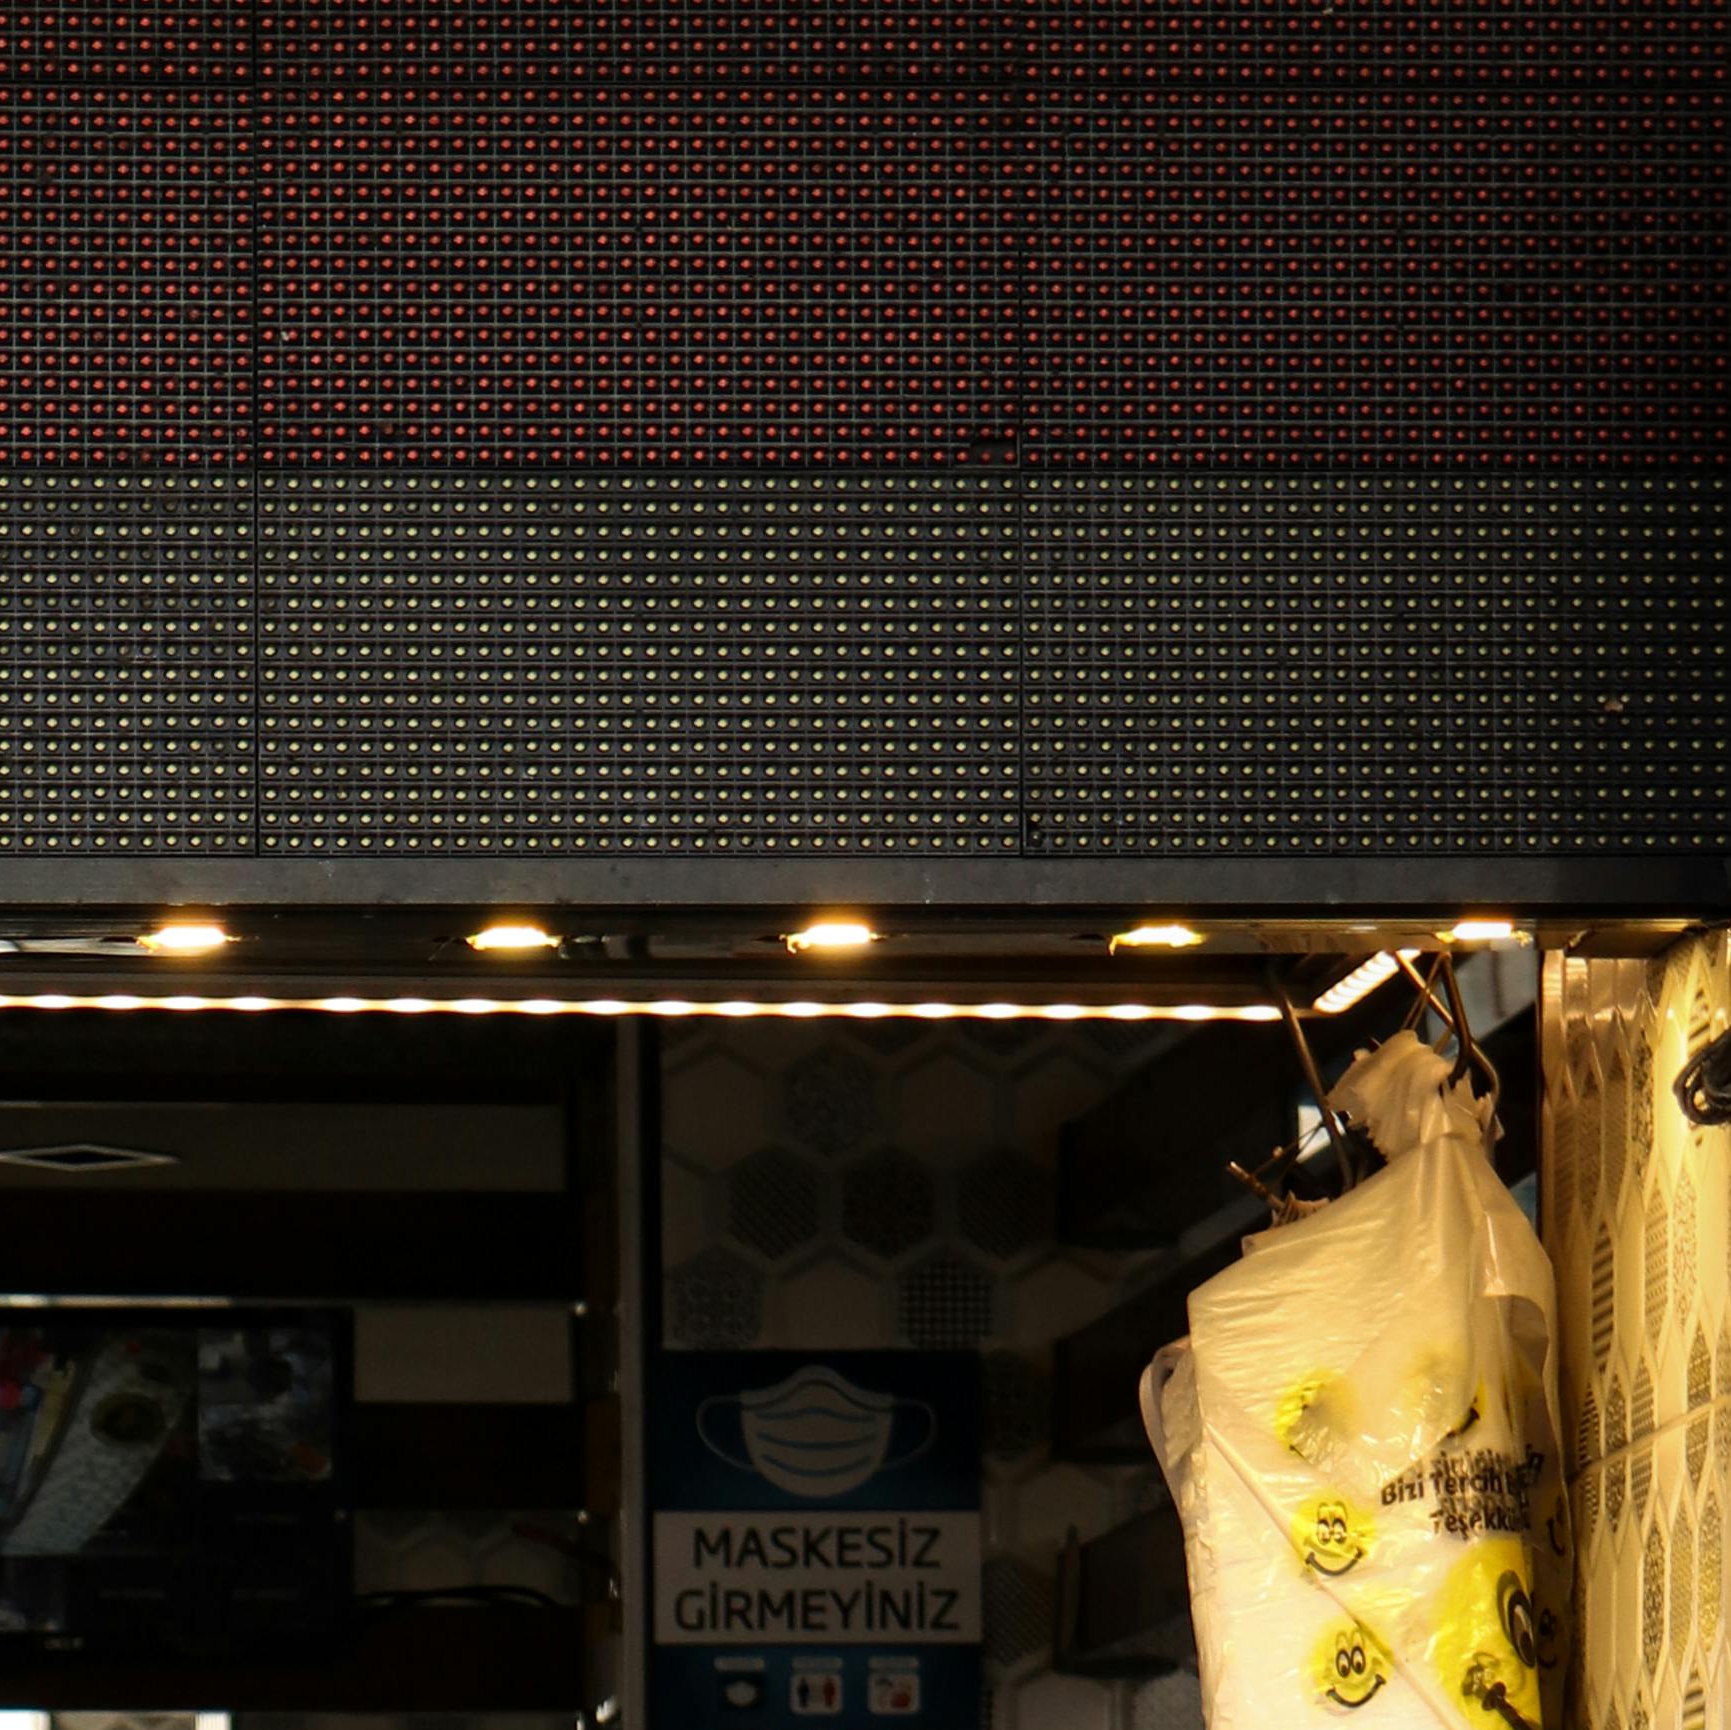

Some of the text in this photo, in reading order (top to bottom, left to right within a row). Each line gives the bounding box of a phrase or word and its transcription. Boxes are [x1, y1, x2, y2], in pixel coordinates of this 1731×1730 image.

[1381, 1474, 1424, 1506] Bizi
[692, 1517, 942, 1569] MASKESİZ
[674, 1581, 961, 1632] GİRMEYİNİZ
